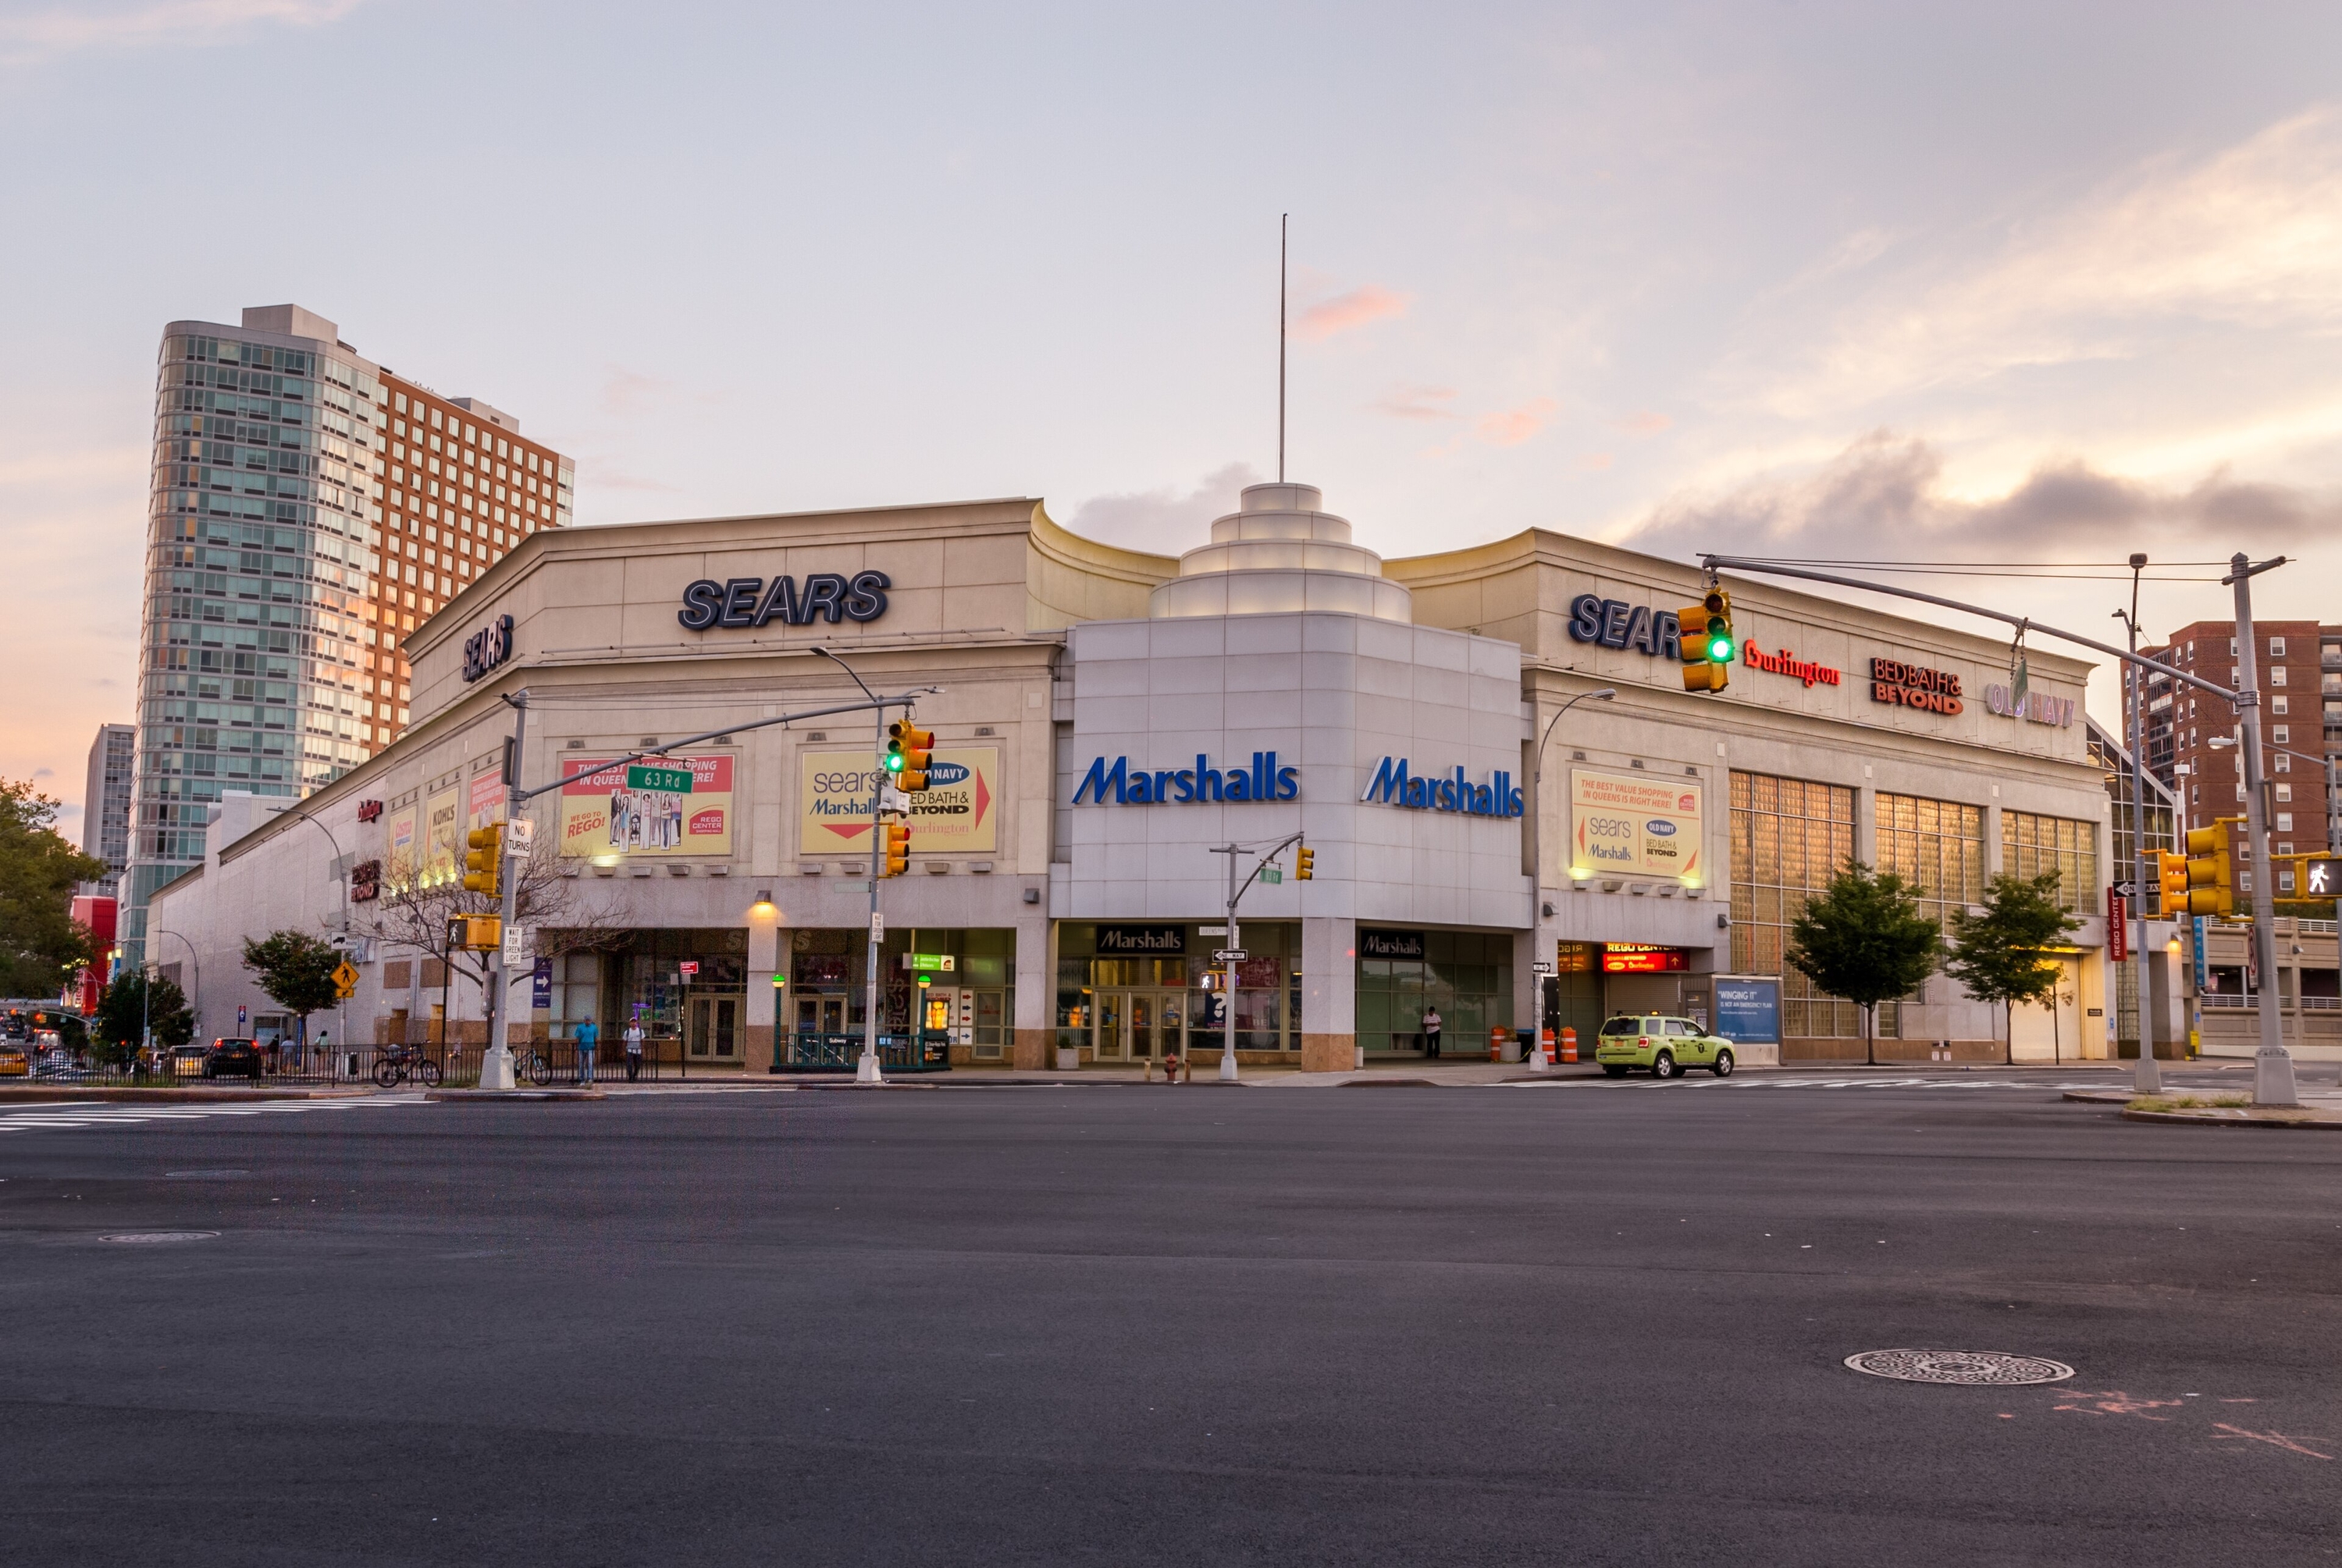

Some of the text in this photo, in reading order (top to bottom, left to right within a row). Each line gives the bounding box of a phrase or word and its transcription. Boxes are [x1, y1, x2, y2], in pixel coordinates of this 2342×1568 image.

[678, 570, 891, 631] SEARS
[1569, 593, 1681, 658] SEAR
[461, 613, 514, 682] SEARS
[1743, 638, 1841, 688] Burlington
[1871, 657, 1963, 696] BED BATH &
[1871, 682, 1963, 715] BEYOND
[2027, 692, 2075, 727] NAVY
[579, 773, 714, 787] IN QUEEN ERE!
[645, 772, 680, 788] 63 Rd
[934, 768, 963, 779] NAVY
[1072, 752, 1299, 804] Marshalls
[1361, 756, 1524, 818] Marshalls
[1581, 779, 1674, 799] THE BEST VALUE SHOPPING
[810, 798, 875, 815] Marshall
[909, 791, 969, 804] ED BATH &
[1582, 790, 1592, 798] IN
[1593, 791, 1621, 802] QUEENS
[1629, 796, 1651, 806] RIGHT
[1651, 799, 1672, 809] HERE!
[432, 804, 454, 827] KOHL'S
[571, 814, 580, 823] WE
[515, 825, 525, 836] NO
[568, 816, 606, 839] REGO!
[1589, 817, 1631, 838] sears
[1649, 822, 1675, 834] OLD NAVY
[508, 840, 530, 852] TURNS
[1588, 843, 1632, 861] Marshalls
[1646, 838, 1657, 848] BED
[1657, 840, 1672, 849] BATH
[1646, 848, 1677, 857] BEYOND
[1101, 930, 1181, 948] Marshalls
[1364, 936, 1422, 955] Marshalls
[2194, 916, 2204, 974] ARKING
